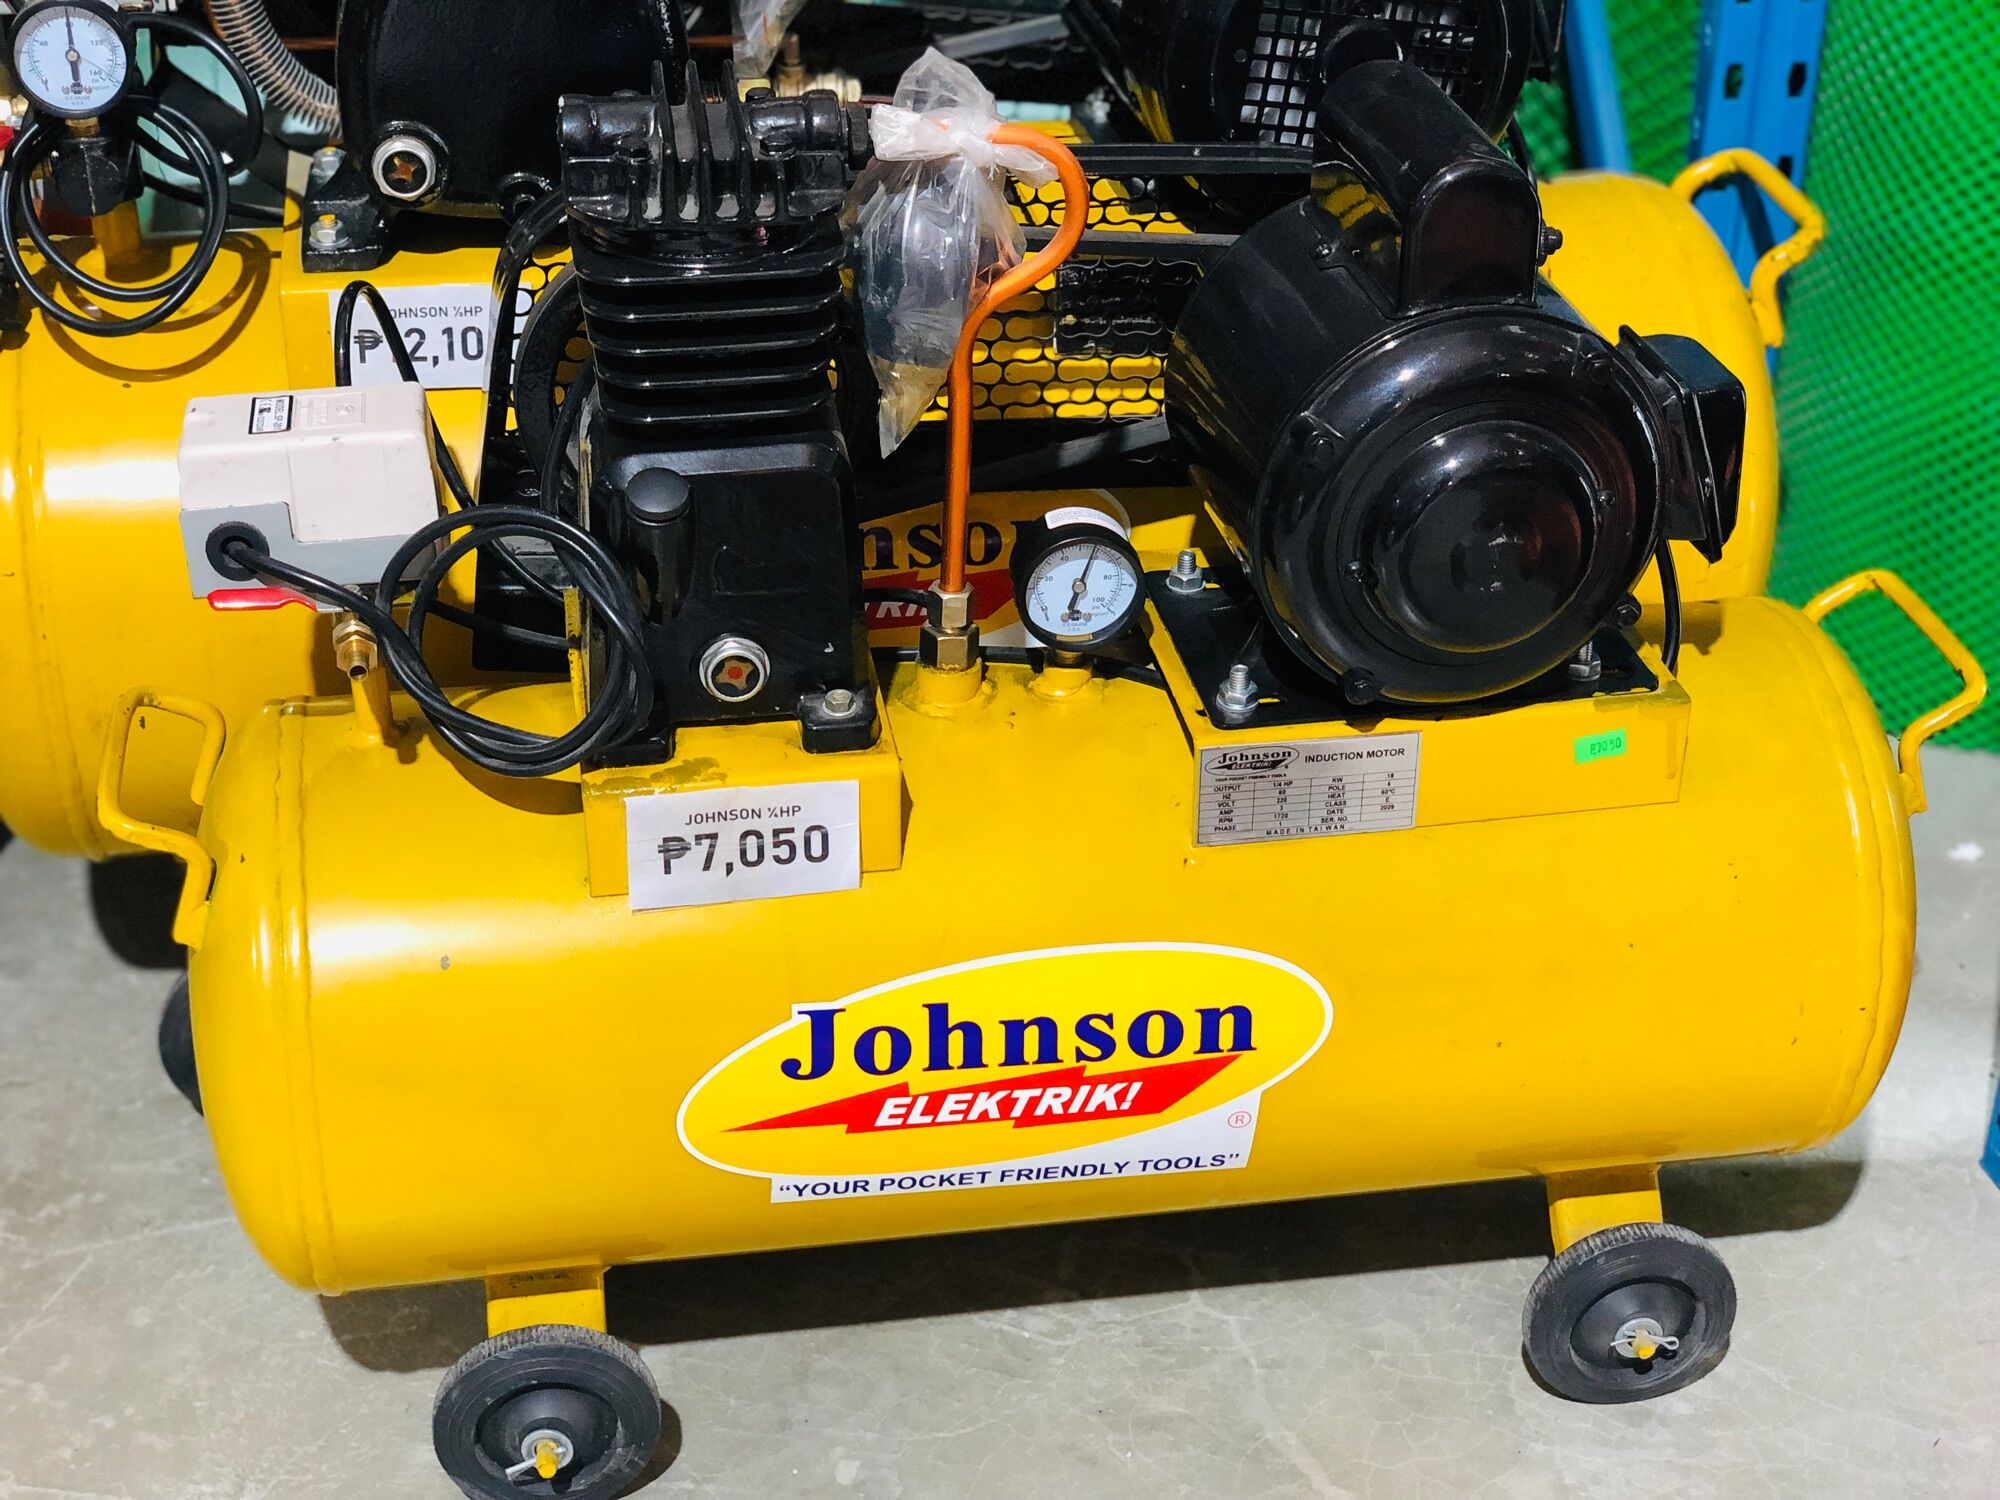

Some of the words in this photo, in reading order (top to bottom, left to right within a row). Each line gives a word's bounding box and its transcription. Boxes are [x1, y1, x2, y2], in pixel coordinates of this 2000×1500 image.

[390, 306, 448, 320] OHNSON
[1218, 750, 1292, 764] Johnson
[1305, 751, 1363, 763] INDUCTION
[1366, 748, 1405, 759] MOTOR
[684, 808, 762, 826] JOHNSON
[1308, 825, 1345, 833] TAIWAN
[780, 1002, 1258, 1081] Johnson
[873, 1081, 1144, 1129] ELEKTRIK!
[878, 1171, 992, 1192] POCKET
[1000, 1161, 1131, 1184] FRIENDLY
